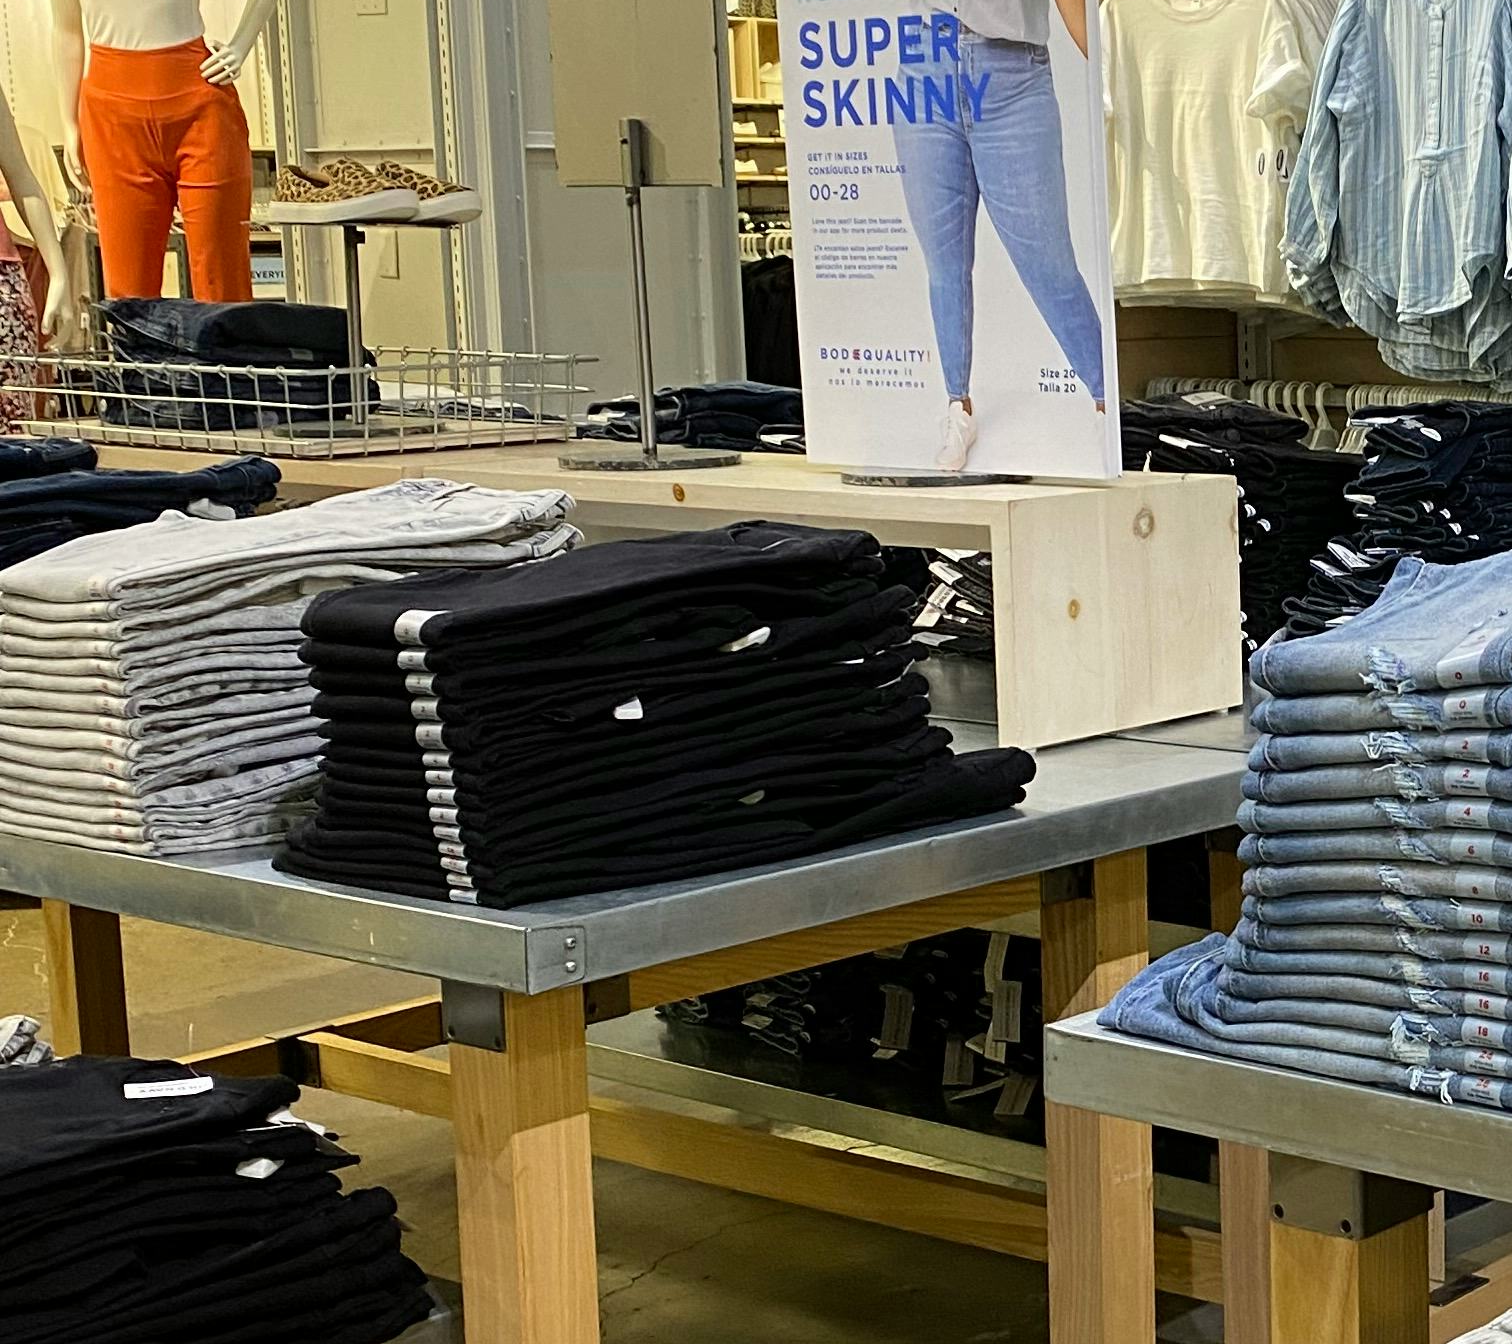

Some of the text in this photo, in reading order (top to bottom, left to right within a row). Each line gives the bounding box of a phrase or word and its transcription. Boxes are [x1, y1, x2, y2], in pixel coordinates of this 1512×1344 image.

[799, 12, 961, 71] SUPER
[802, 72, 990, 129] SKINNY
[807, 152, 867, 161] GET IT IN SIZES
[809, 165, 858, 175] CONSÍGUELO
[876, 165, 905, 173] TALLAS
[810, 184, 859, 200] 00-28
[1040, 368, 1076, 378] Size 20
[1039, 383, 1076, 393] Talla 20
[1471, 914, 1483, 923] 10
